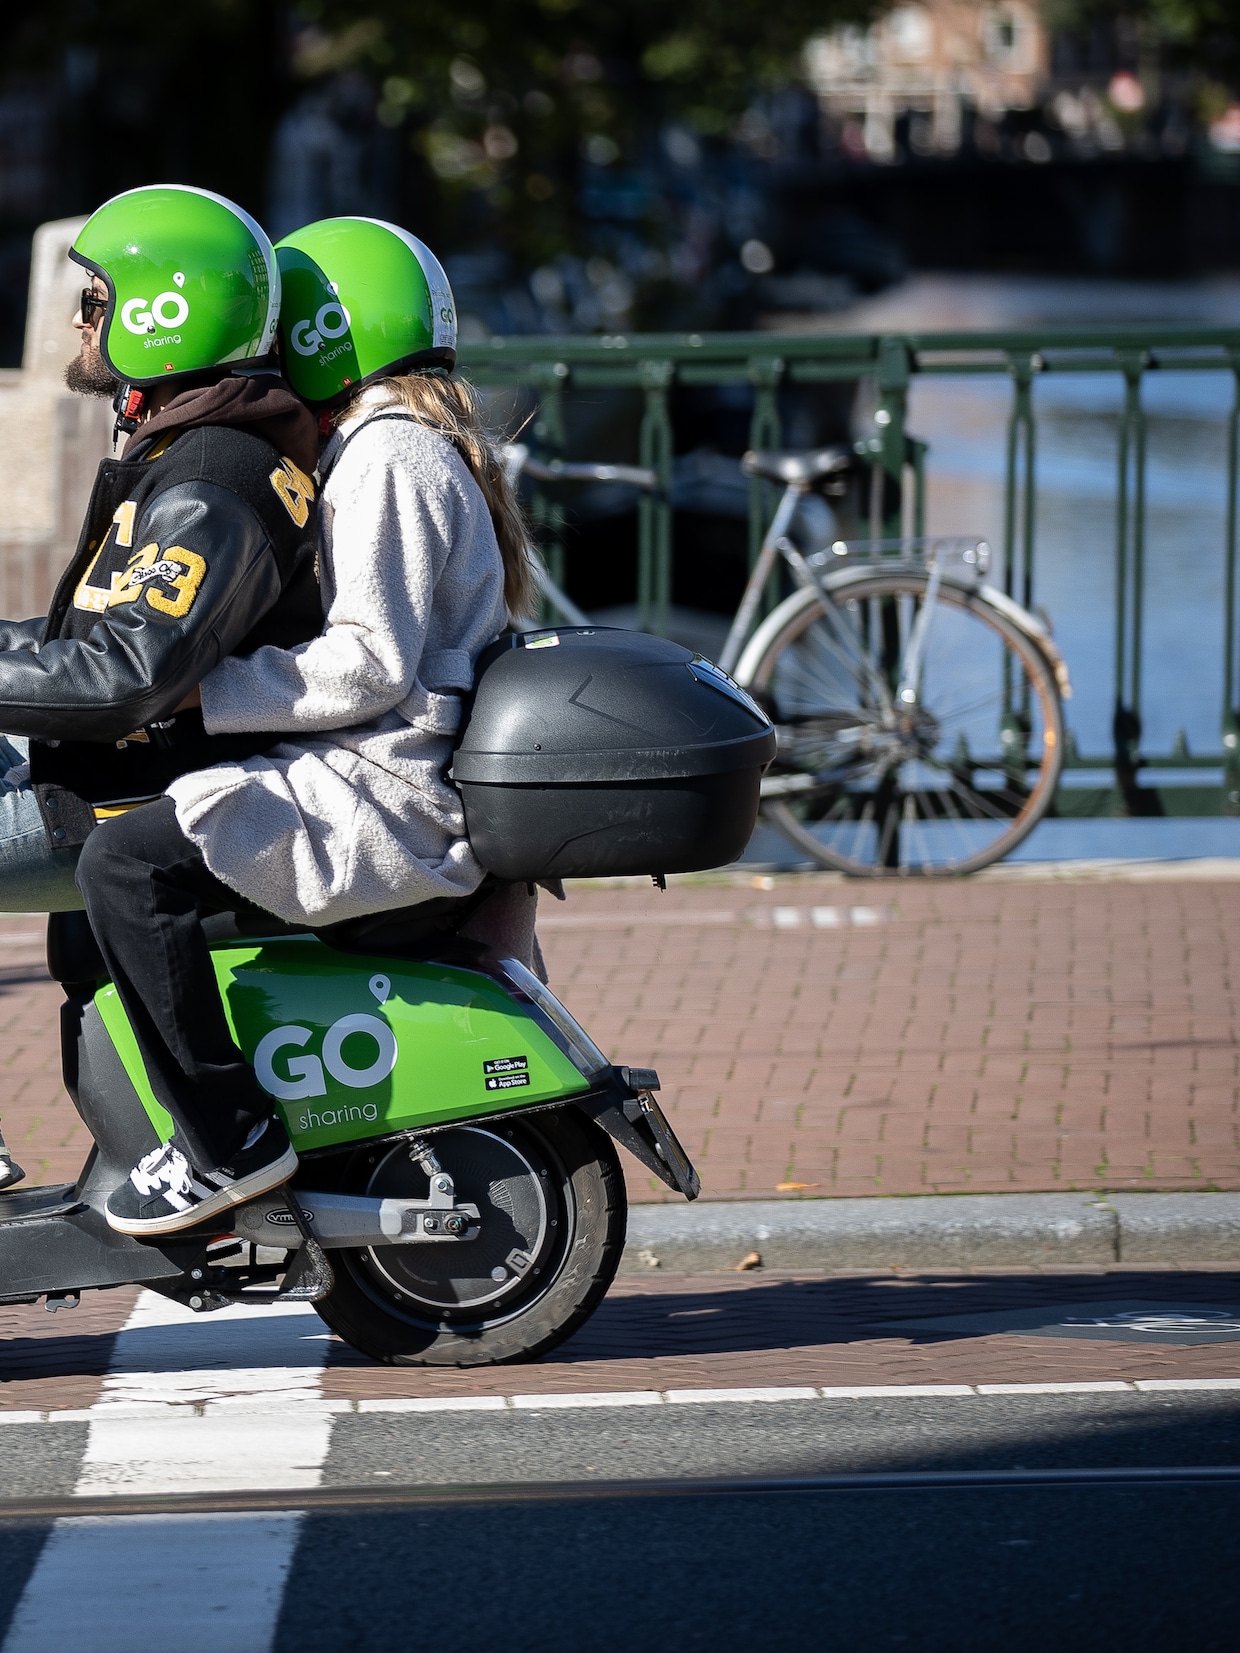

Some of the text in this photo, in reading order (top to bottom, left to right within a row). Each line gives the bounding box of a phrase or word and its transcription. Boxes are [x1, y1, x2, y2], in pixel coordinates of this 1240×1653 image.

[121, 291, 189, 335] GO
[143, 334, 182, 349] sharing
[291, 302, 351, 356] GO
[318, 341, 353, 367] sharing
[253, 1013, 398, 1100] GO
[494, 1063, 515, 1071] Google
[298, 1102, 378, 1130] sharing
